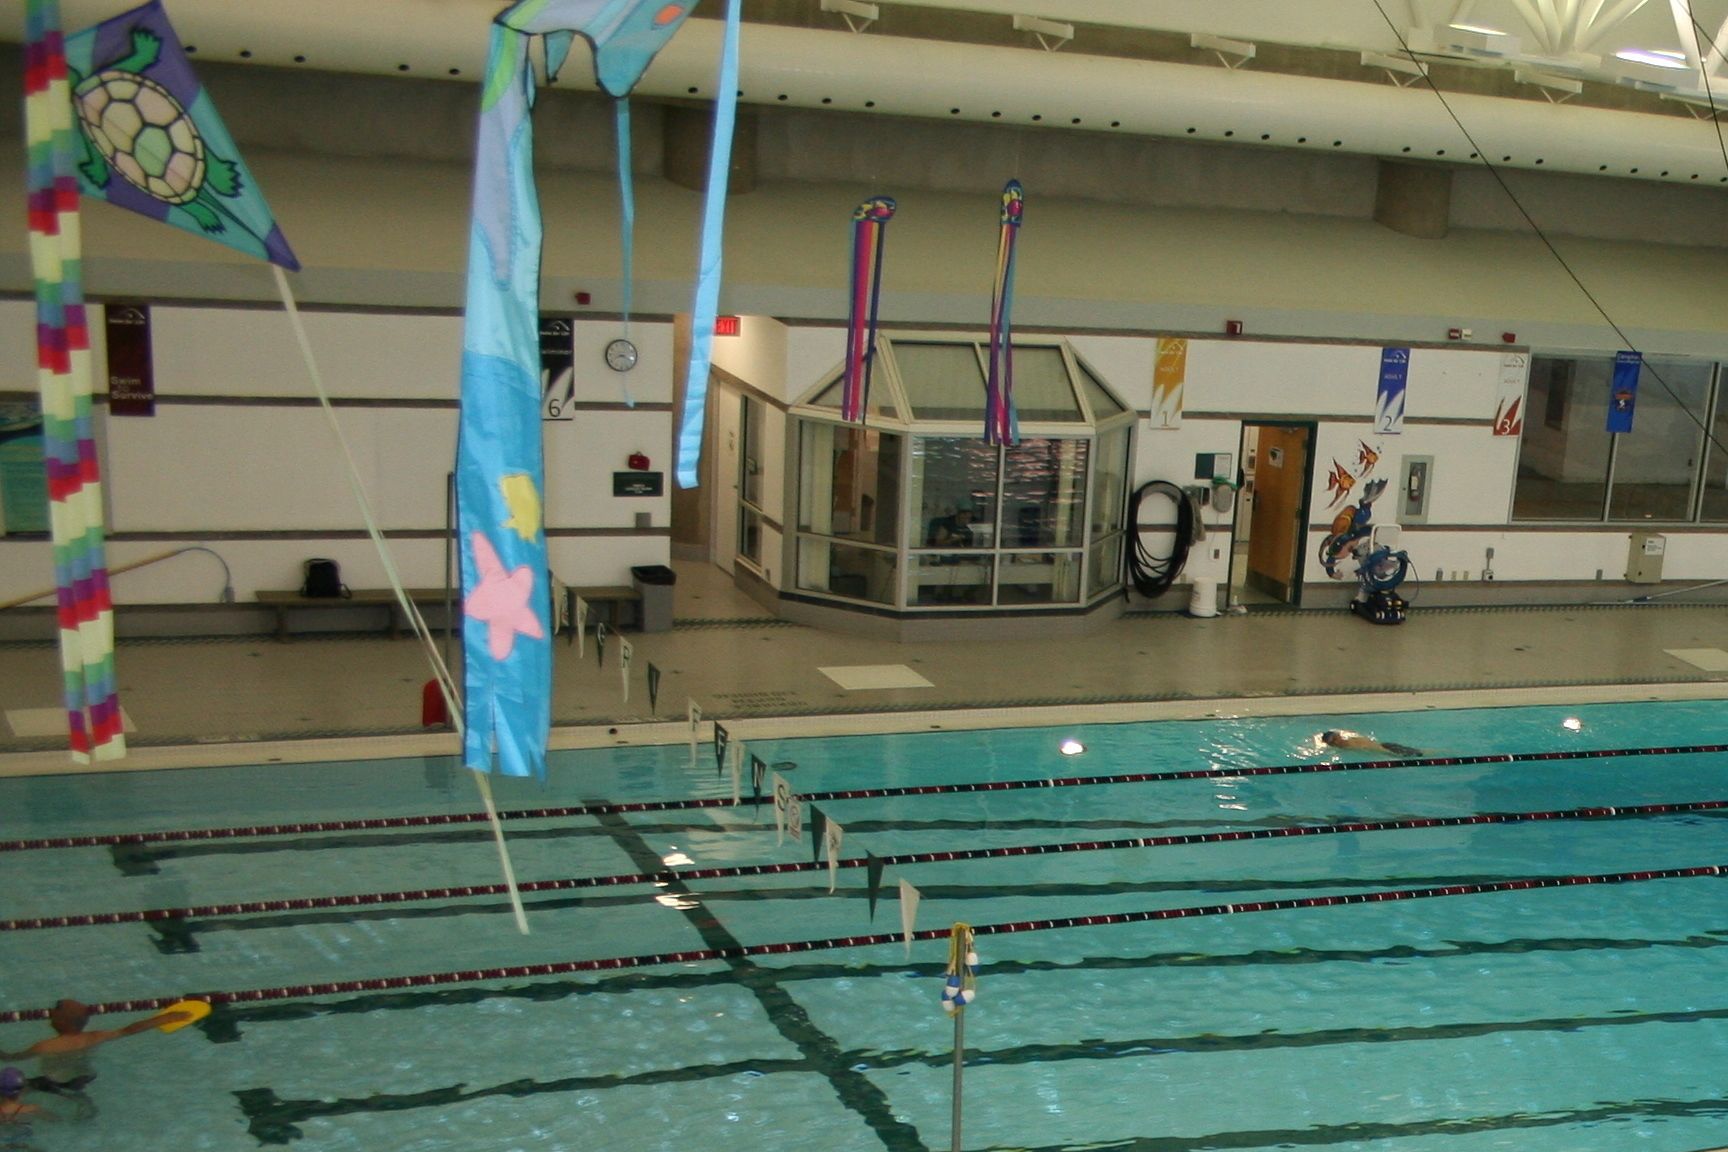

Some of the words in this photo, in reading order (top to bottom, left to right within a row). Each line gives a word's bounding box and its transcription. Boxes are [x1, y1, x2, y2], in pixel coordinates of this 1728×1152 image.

[548, 398, 561, 417] 6
[1161, 411, 1169, 426] 1
[1383, 415, 1393, 432] 2
[1501, 418, 1511, 435] 3
